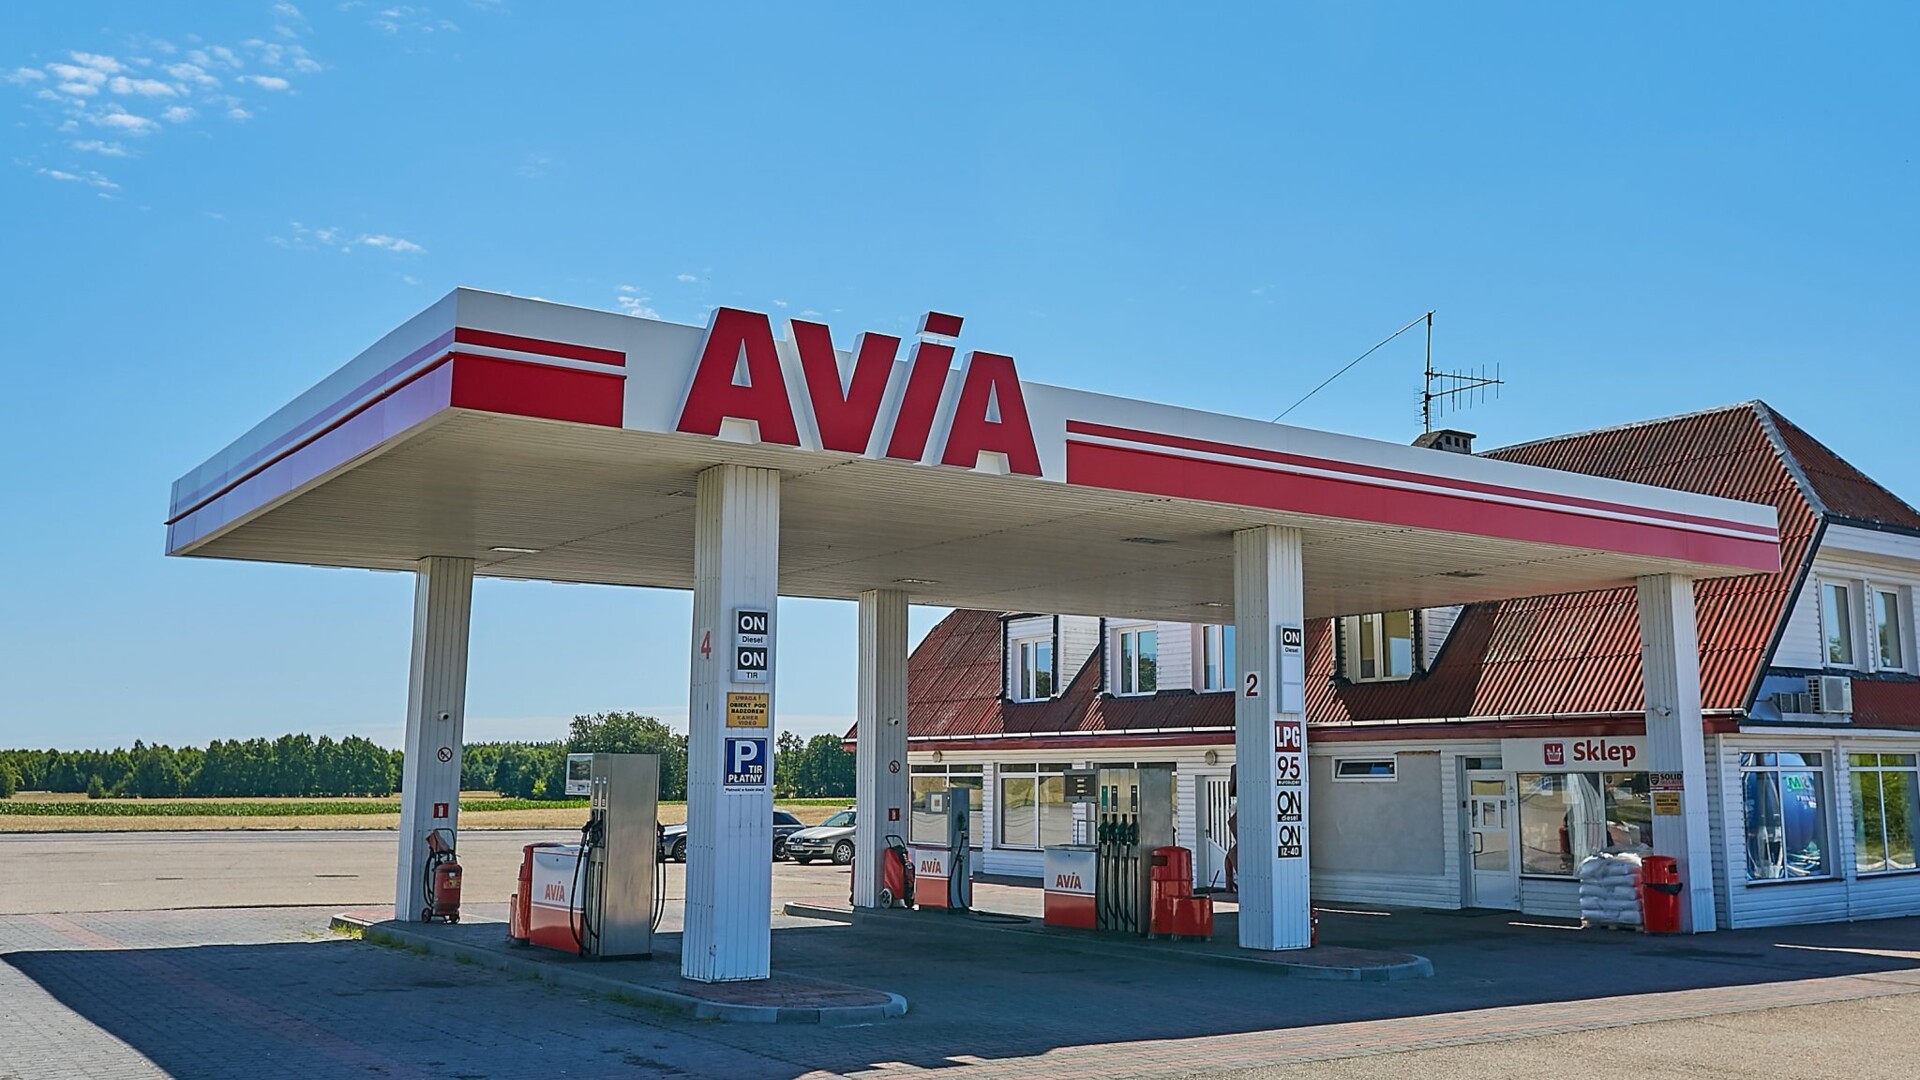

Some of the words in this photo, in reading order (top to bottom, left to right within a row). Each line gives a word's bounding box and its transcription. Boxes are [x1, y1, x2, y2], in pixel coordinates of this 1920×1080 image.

[740, 615, 765, 631] ON
[701, 630, 712, 660] 4
[742, 635, 763, 643] Diesel
[1284, 631, 1300, 643] ON
[740, 651, 765, 667] ON
[746, 671, 758, 679] TIR
[1245, 673, 1258, 697] 2
[1276, 726, 1301, 748] LPG
[734, 741, 758, 773] P
[1573, 740, 1636, 767] Sklep
[748, 765, 763, 774] TIR
[1277, 756, 1301, 779] 95
[728, 774, 763, 783] PŁATNY
[1660, 773, 1684, 781] SOLID
[1277, 790, 1302, 814] ON
[1279, 825, 1301, 846] ON
